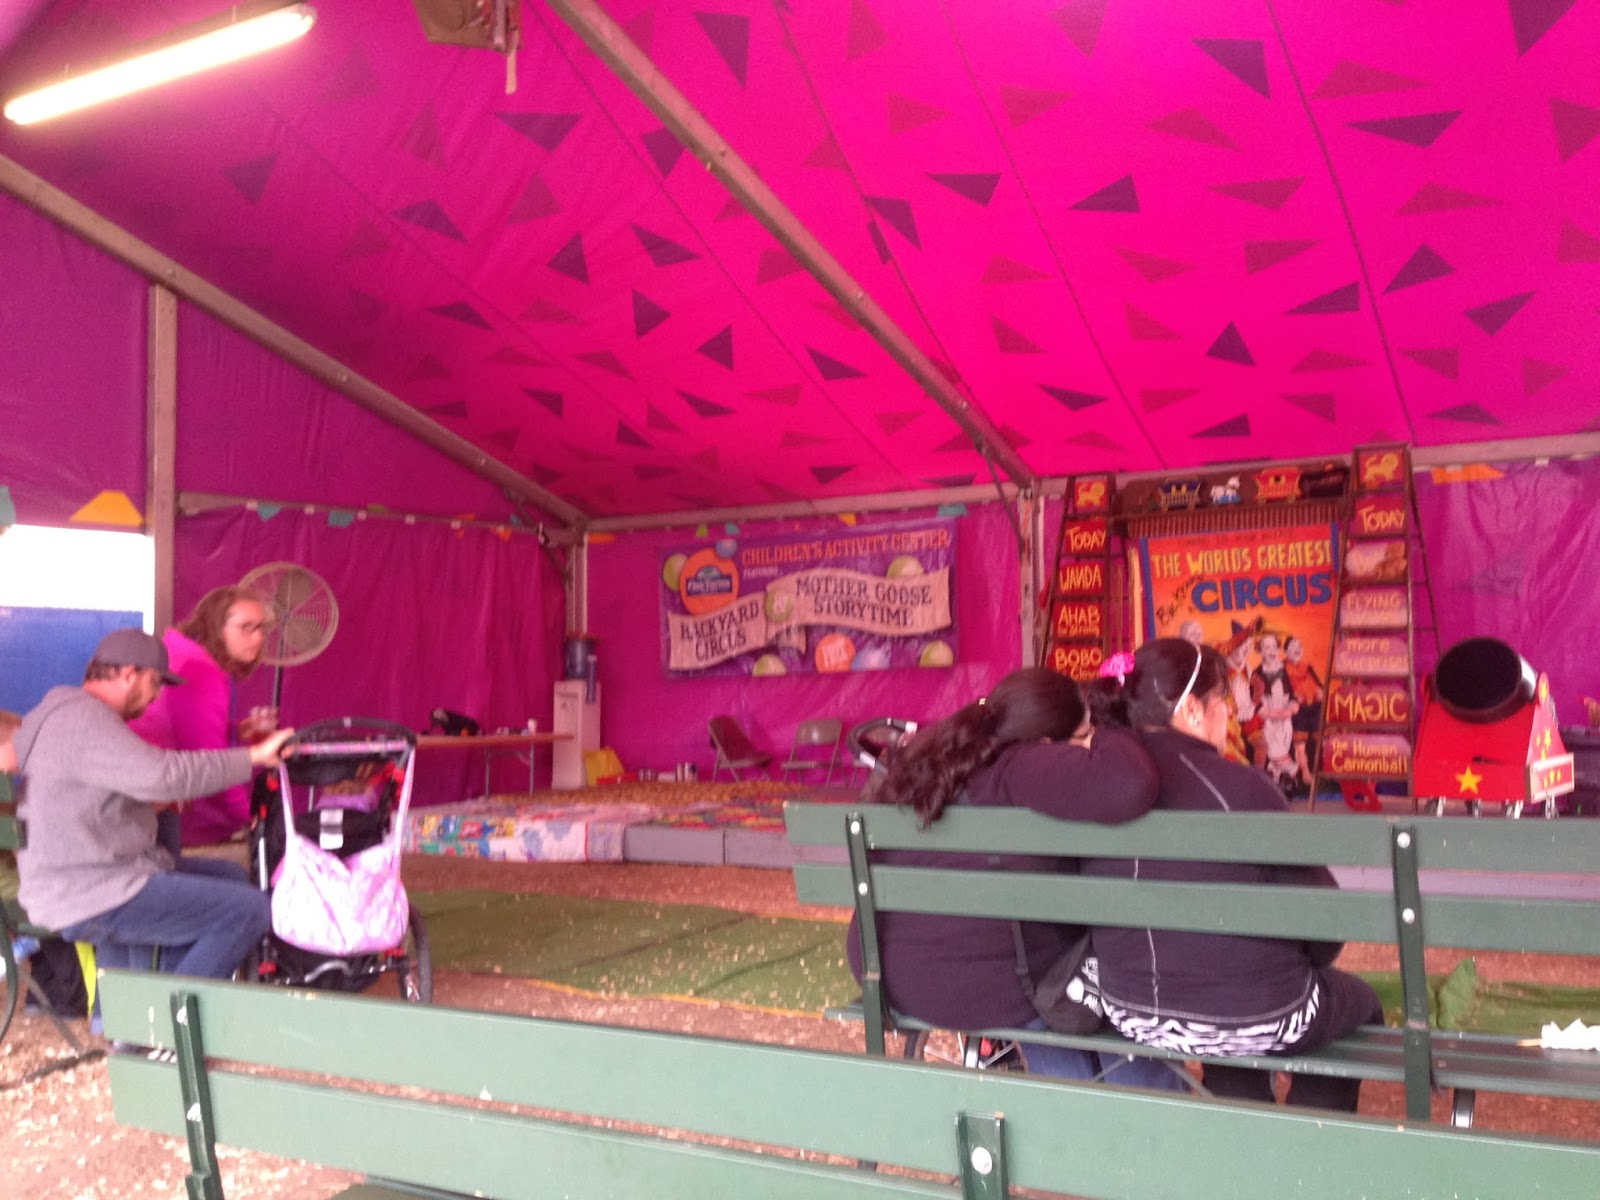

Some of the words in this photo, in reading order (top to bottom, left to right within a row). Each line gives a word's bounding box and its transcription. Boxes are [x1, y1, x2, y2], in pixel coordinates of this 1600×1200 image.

[1359, 505, 1405, 533] TODAY
[825, 534, 888, 560] ACTIVITY
[891, 528, 948, 551] CENTER
[1067, 526, 1106, 552] TODAY
[1152, 553, 1181, 578] THE
[1256, 540, 1331, 570] GREATEST
[796, 575, 869, 600] MOTHER
[875, 582, 932, 607] GOOSE
[1191, 572, 1332, 613] CIRCUS
[680, 602, 759, 640] BACKYARD
[814, 594, 914, 626] STORYTIME
[1058, 605, 1100, 626] AHAB
[696, 629, 747, 660] CIRCUS
[1055, 648, 1102, 671] BOBO
[1334, 691, 1407, 722] MAGIC
[1331, 749, 1408, 774] Cannonball
[1353, 739, 1397, 757] Human
